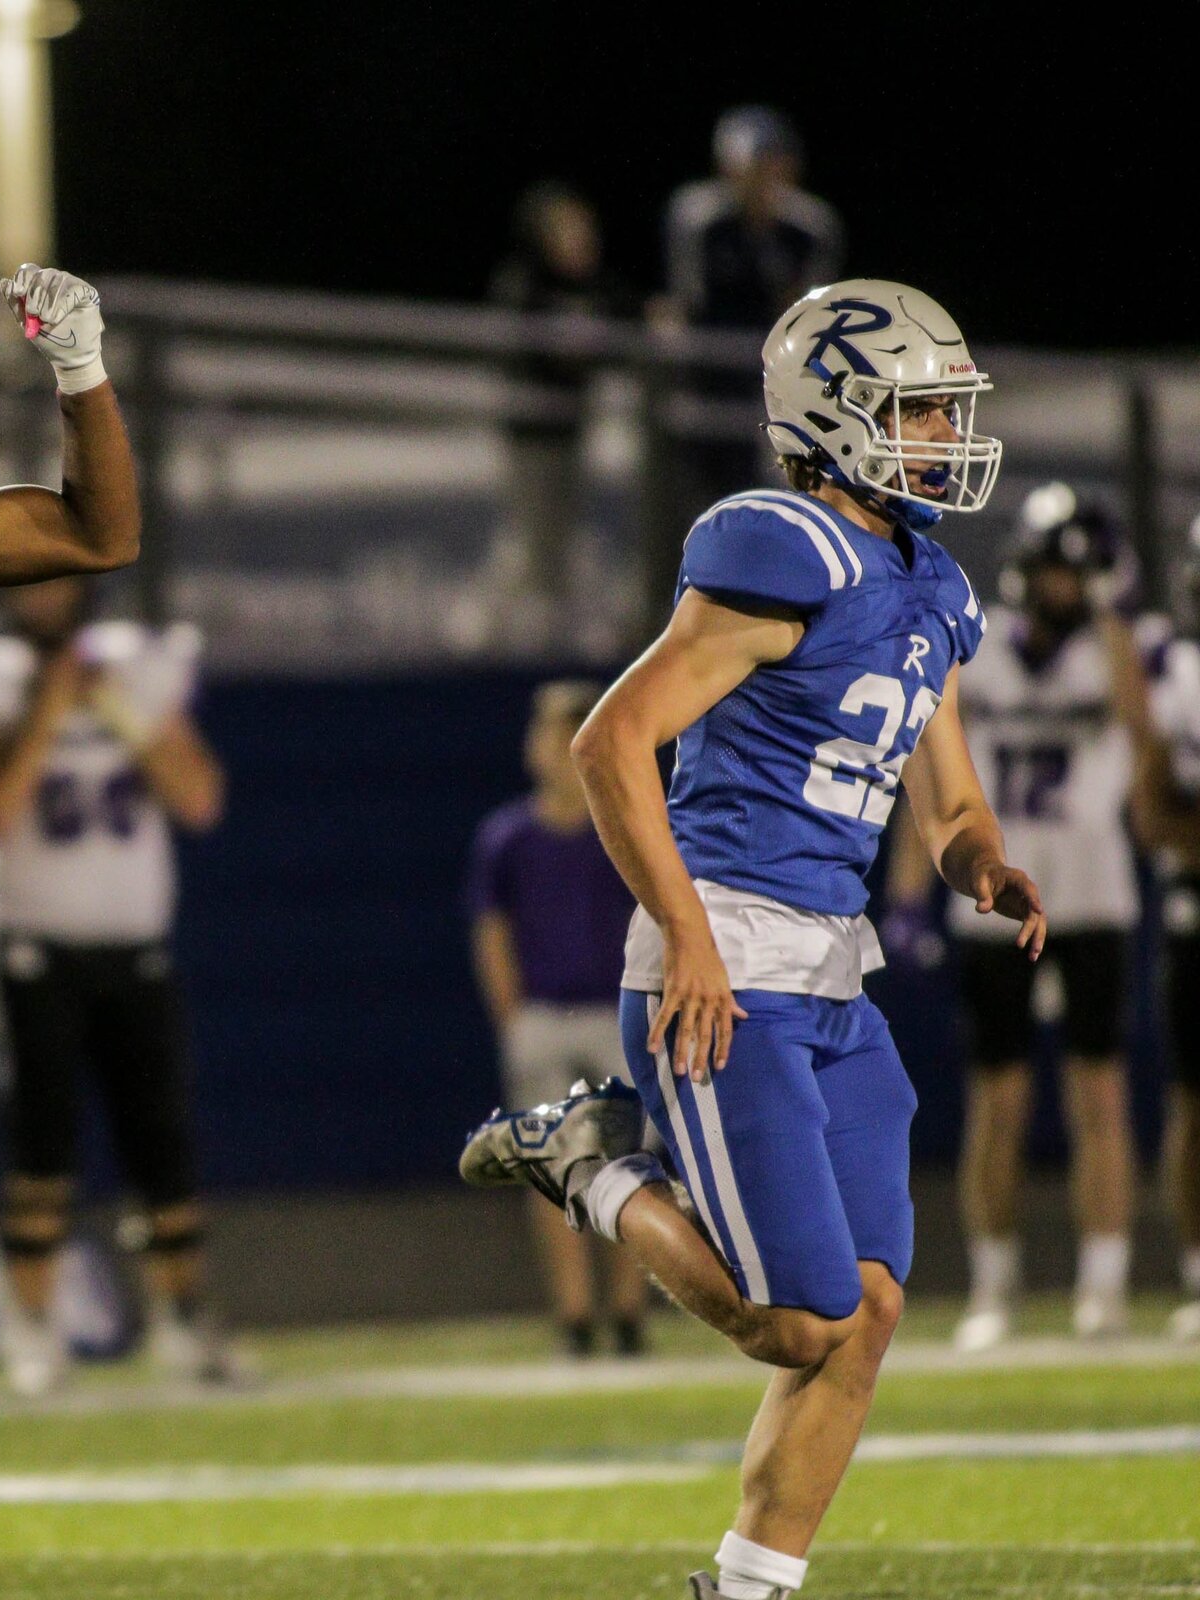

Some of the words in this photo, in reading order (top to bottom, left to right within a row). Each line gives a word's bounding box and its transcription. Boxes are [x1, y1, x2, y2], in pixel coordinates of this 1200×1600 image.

[804, 301, 893, 377] R
[948, 363, 975, 374] Ridd
[903, 634, 930, 677] R
